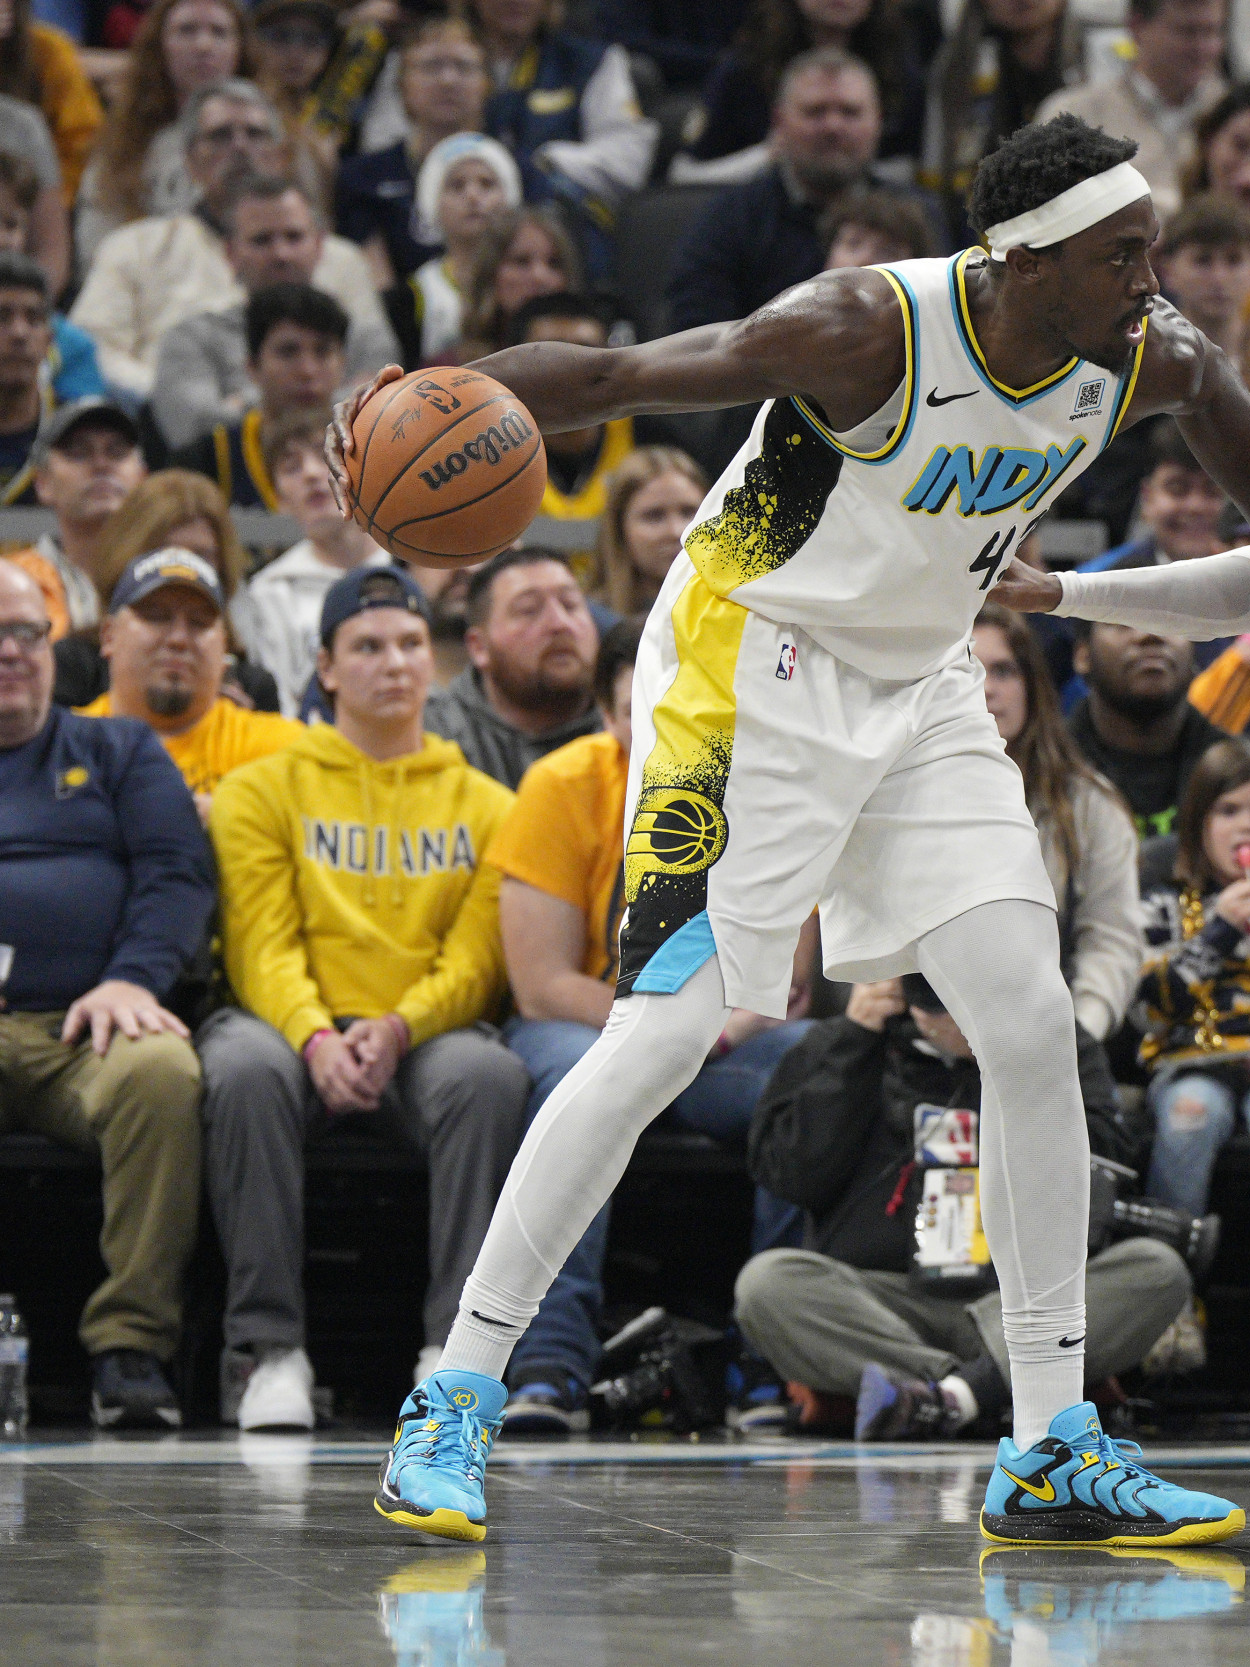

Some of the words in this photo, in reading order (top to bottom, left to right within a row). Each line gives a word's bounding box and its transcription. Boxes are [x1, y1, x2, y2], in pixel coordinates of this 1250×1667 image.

[418, 409, 533, 491] Wilson
[1069, 410, 1102, 421] spokenote
[901, 435, 1089, 518] INDY
[302, 815, 476, 877] INDIANA
